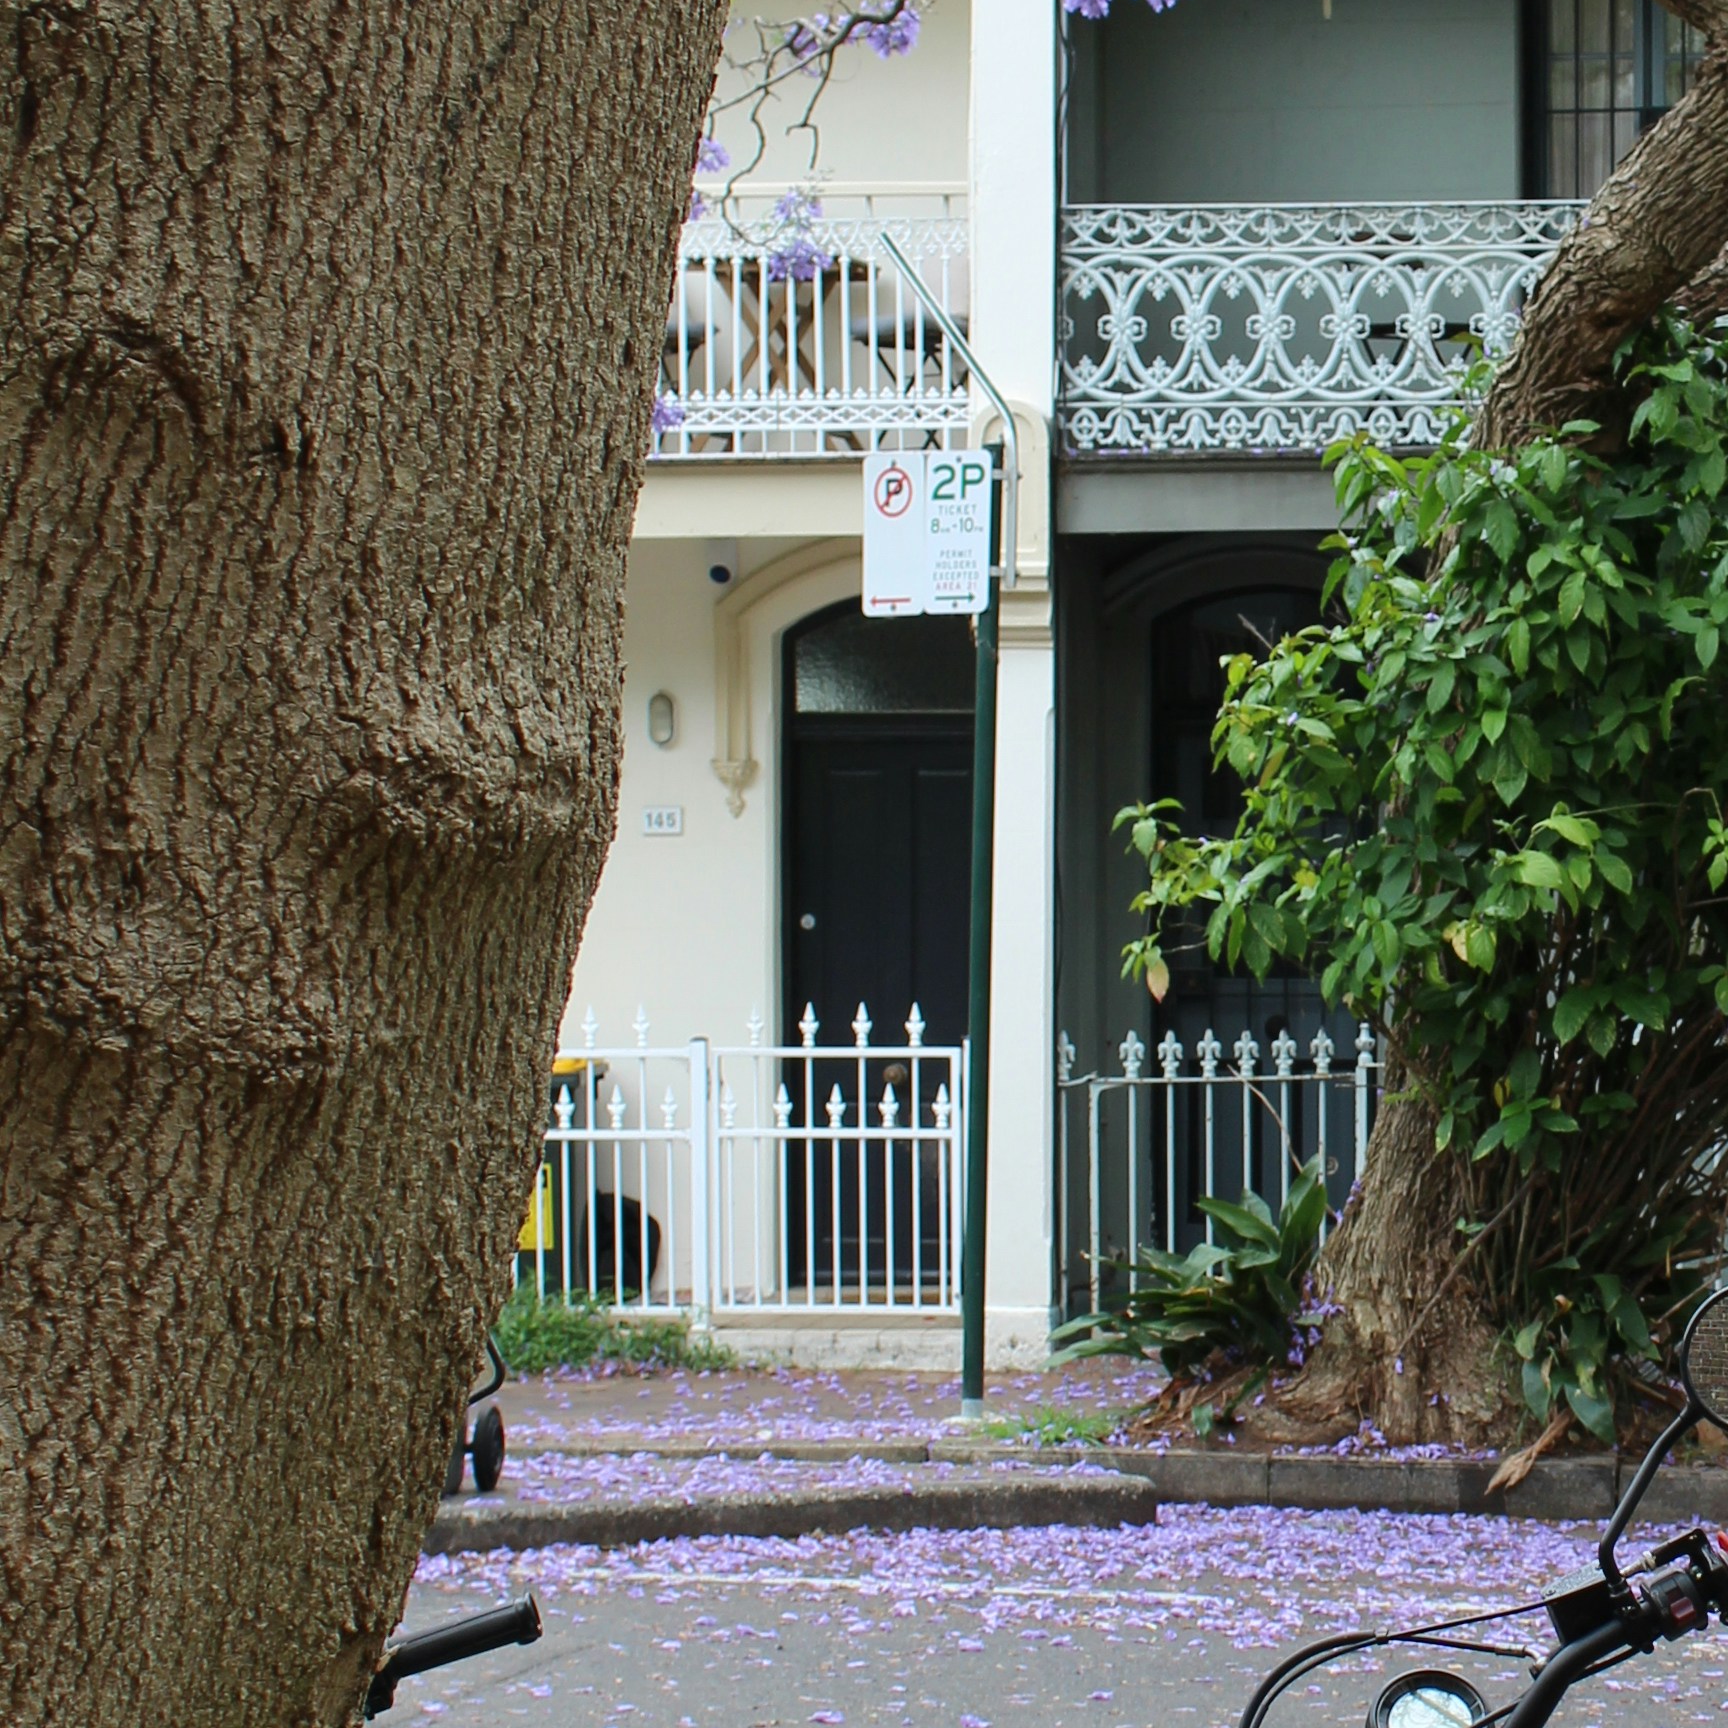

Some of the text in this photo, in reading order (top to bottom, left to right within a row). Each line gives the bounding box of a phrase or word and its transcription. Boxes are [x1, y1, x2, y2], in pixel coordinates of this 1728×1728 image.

[931, 463, 985, 500] 2P
[938, 504, 977, 516] TICKET
[940, 549, 972, 559] PERMIT
[935, 560, 977, 570] HOLDERS
[932, 571, 979, 581] EXCEPTED
[936, 582, 961, 591] AREA
